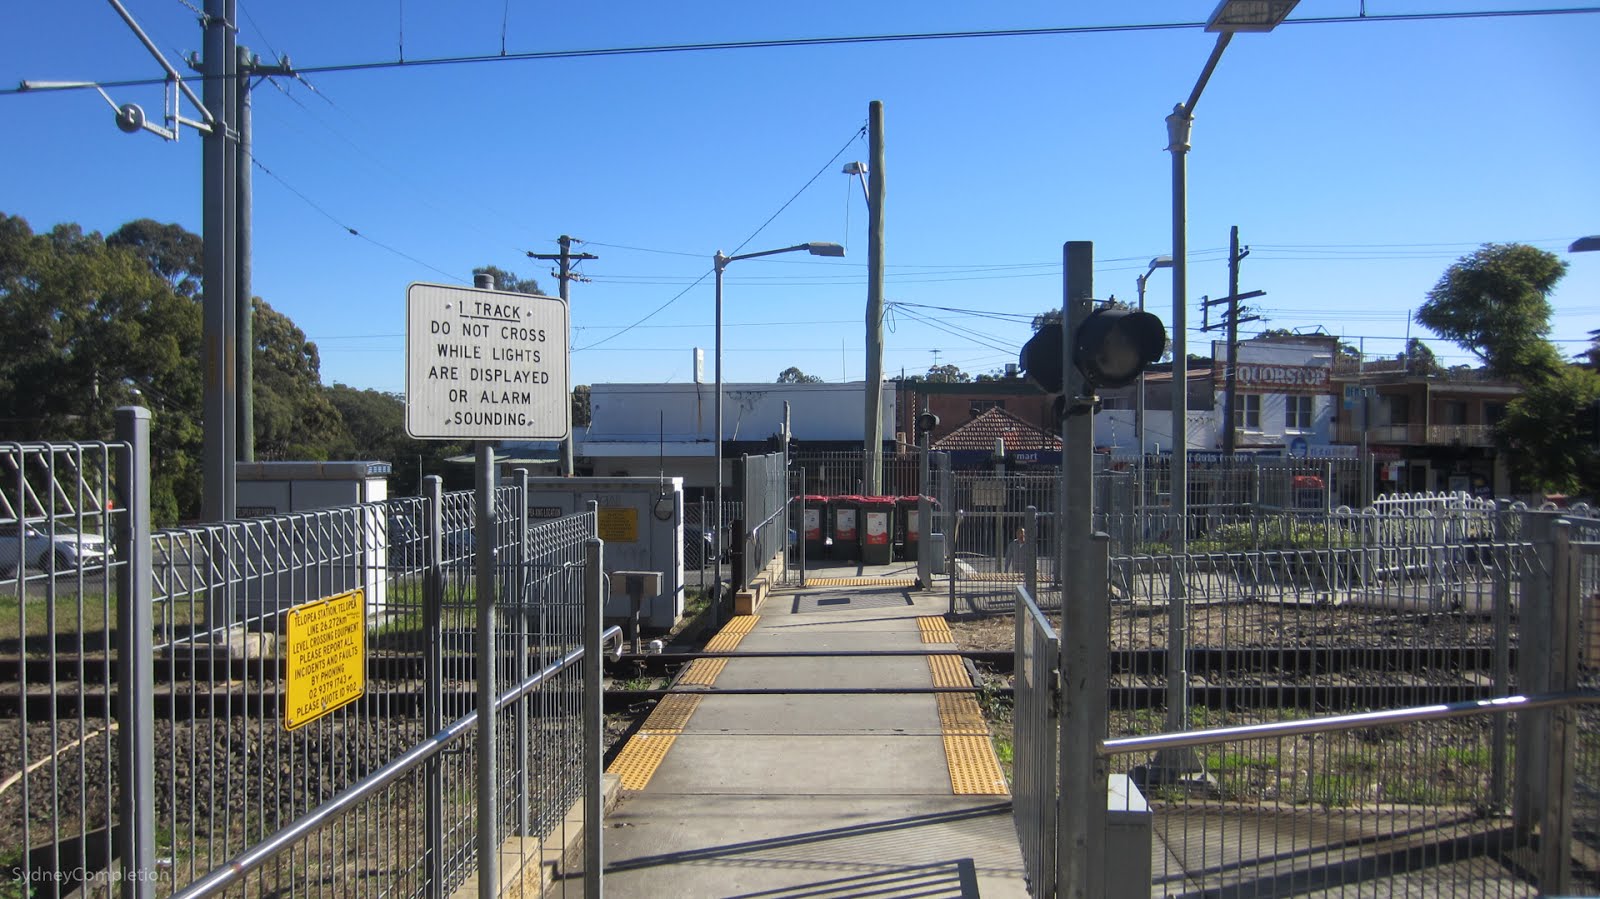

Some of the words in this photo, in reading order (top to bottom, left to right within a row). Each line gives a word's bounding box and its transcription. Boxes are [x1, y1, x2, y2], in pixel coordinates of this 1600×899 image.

[459, 300, 463, 314] 1
[475, 302, 521, 319] TRACK
[431, 320, 451, 335] DO
[462, 323, 490, 338] NOT
[501, 326, 546, 342] CROSS
[437, 343, 481, 360] WHILE
[493, 347, 541, 363] LIGHTS
[428, 366, 459, 381] ARE
[470, 368, 549, 385] DISPLAYED
[449, 389, 468, 403] OR
[480, 391, 531, 405] ALARM
[454, 411, 526, 426] SOUNDING
[294, 612, 317, 627] TELOPEA
[338, 599, 357, 613] TELOPEA
[293, 640, 309, 654] LEVEL
[310, 631, 334, 648] CROSSING
[335, 622, 359, 639] EQUIPMENT
[307, 623, 319, 636] LINE
[300, 647, 321, 665] PLEASE
[323, 639, 343, 656] REPORT
[344, 636, 354, 647] ALL
[295, 659, 325, 680] INCIDENTS
[327, 654, 338, 666] AND
[339, 646, 358, 661] FAULTS
[311, 673, 319, 686] BY
[321, 663, 344, 681] PHONING
[296, 699, 320, 718] PLEASE
[321, 690, 339, 706] QUOTE
[346, 681, 357, 693] 902
[309, 688, 317, 699] 02
[319, 680, 333, 694] 9379
